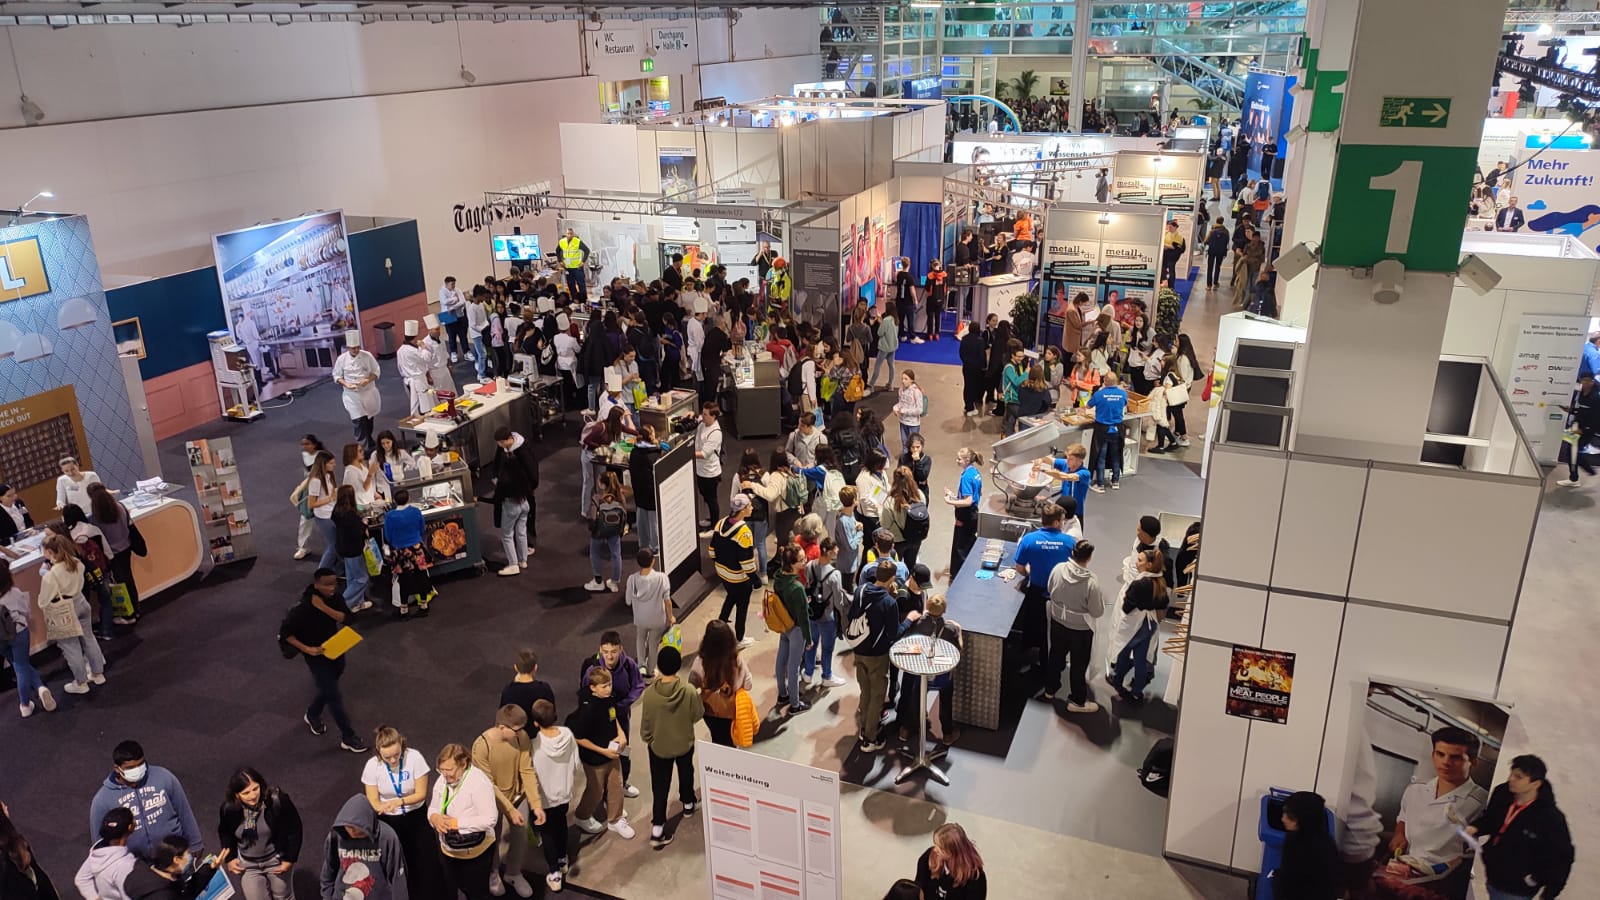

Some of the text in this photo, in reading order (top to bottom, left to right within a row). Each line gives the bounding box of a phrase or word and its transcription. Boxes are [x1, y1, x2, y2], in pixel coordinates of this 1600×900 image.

[604, 33, 614, 41] WC
[659, 31, 684, 41] Durchgang
[605, 45, 634, 54] Restaurant
[663, 42, 675, 50] Halle
[1527, 159, 1569, 170] Mehr
[1524, 174, 1594, 186] Zukunft!
[1369, 161, 1423, 254] 1
[453, 203, 494, 233] Tages
[10, 407, 19, 415] IN
[17, 412, 32, 422] OUT
[1230, 687, 1253, 697] MEAT
[1255, 692, 1288, 702] PEOPLE
[704, 765, 770, 788] Weiterbildung
